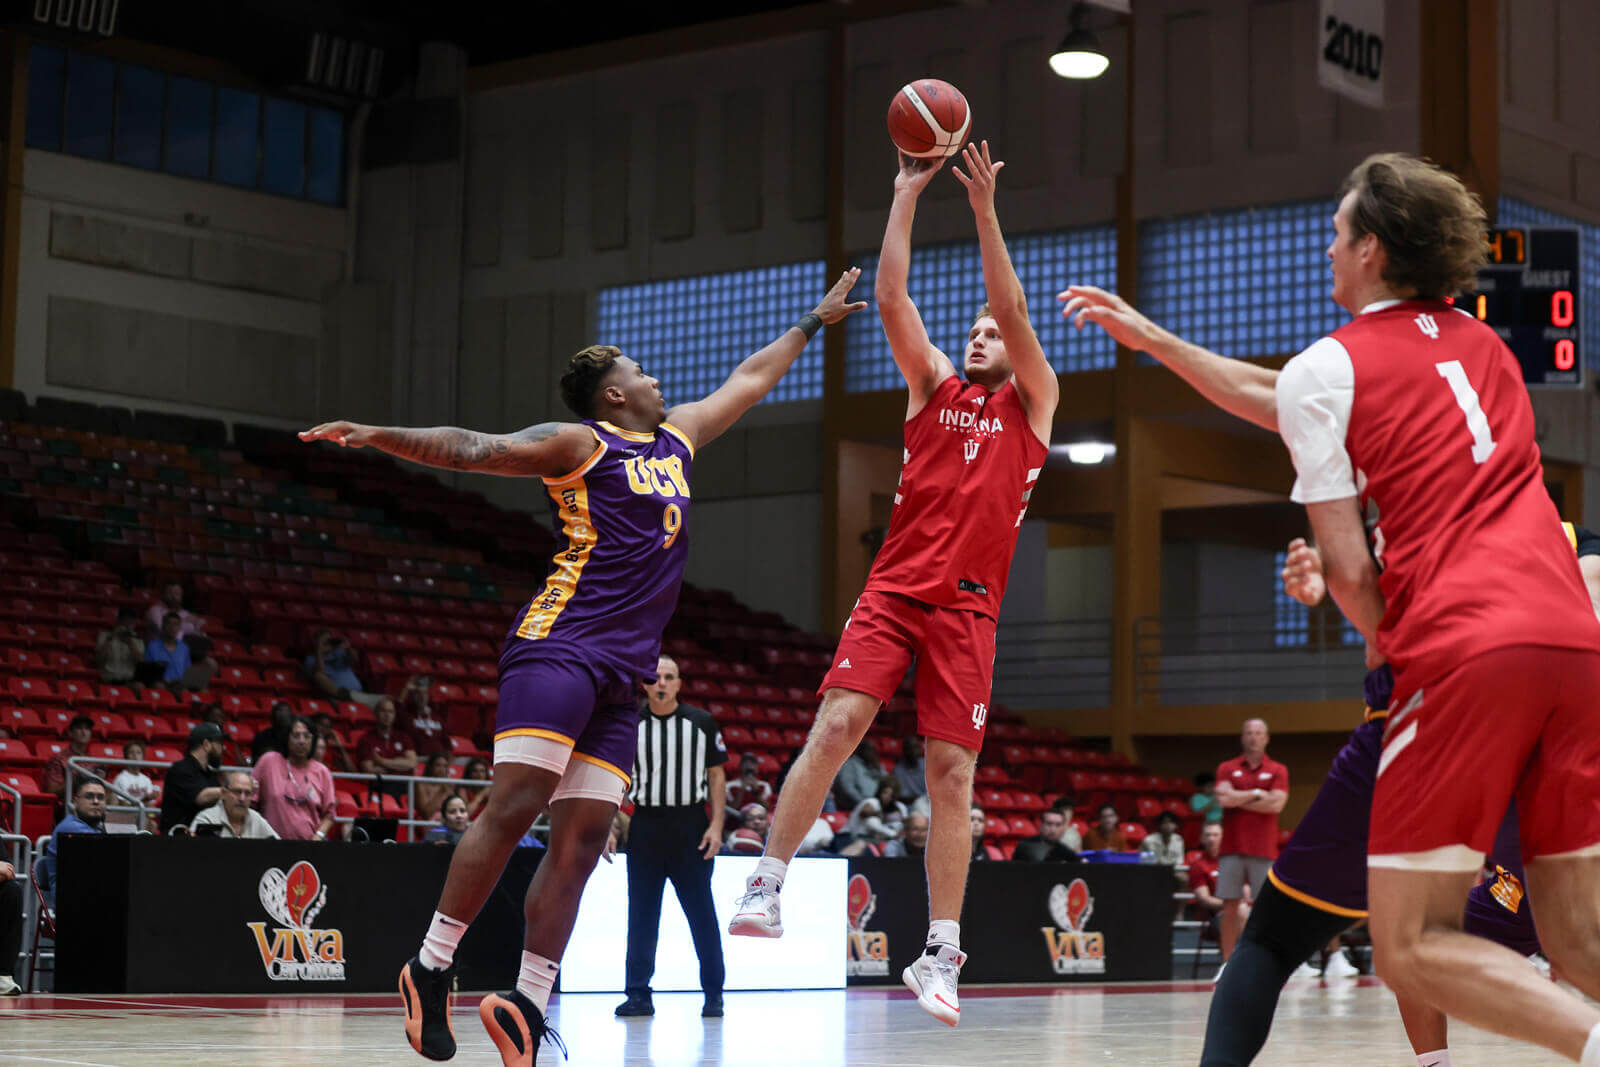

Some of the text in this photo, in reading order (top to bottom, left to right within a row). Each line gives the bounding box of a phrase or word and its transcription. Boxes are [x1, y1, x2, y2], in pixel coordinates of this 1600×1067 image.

[1324, 14, 1383, 82] 2010
[1551, 290, 1574, 327] 0
[1555, 339, 1575, 370] 0
[1435, 360, 1498, 464] 1
[619, 454, 691, 498] UCB
[662, 503, 682, 549] 9
